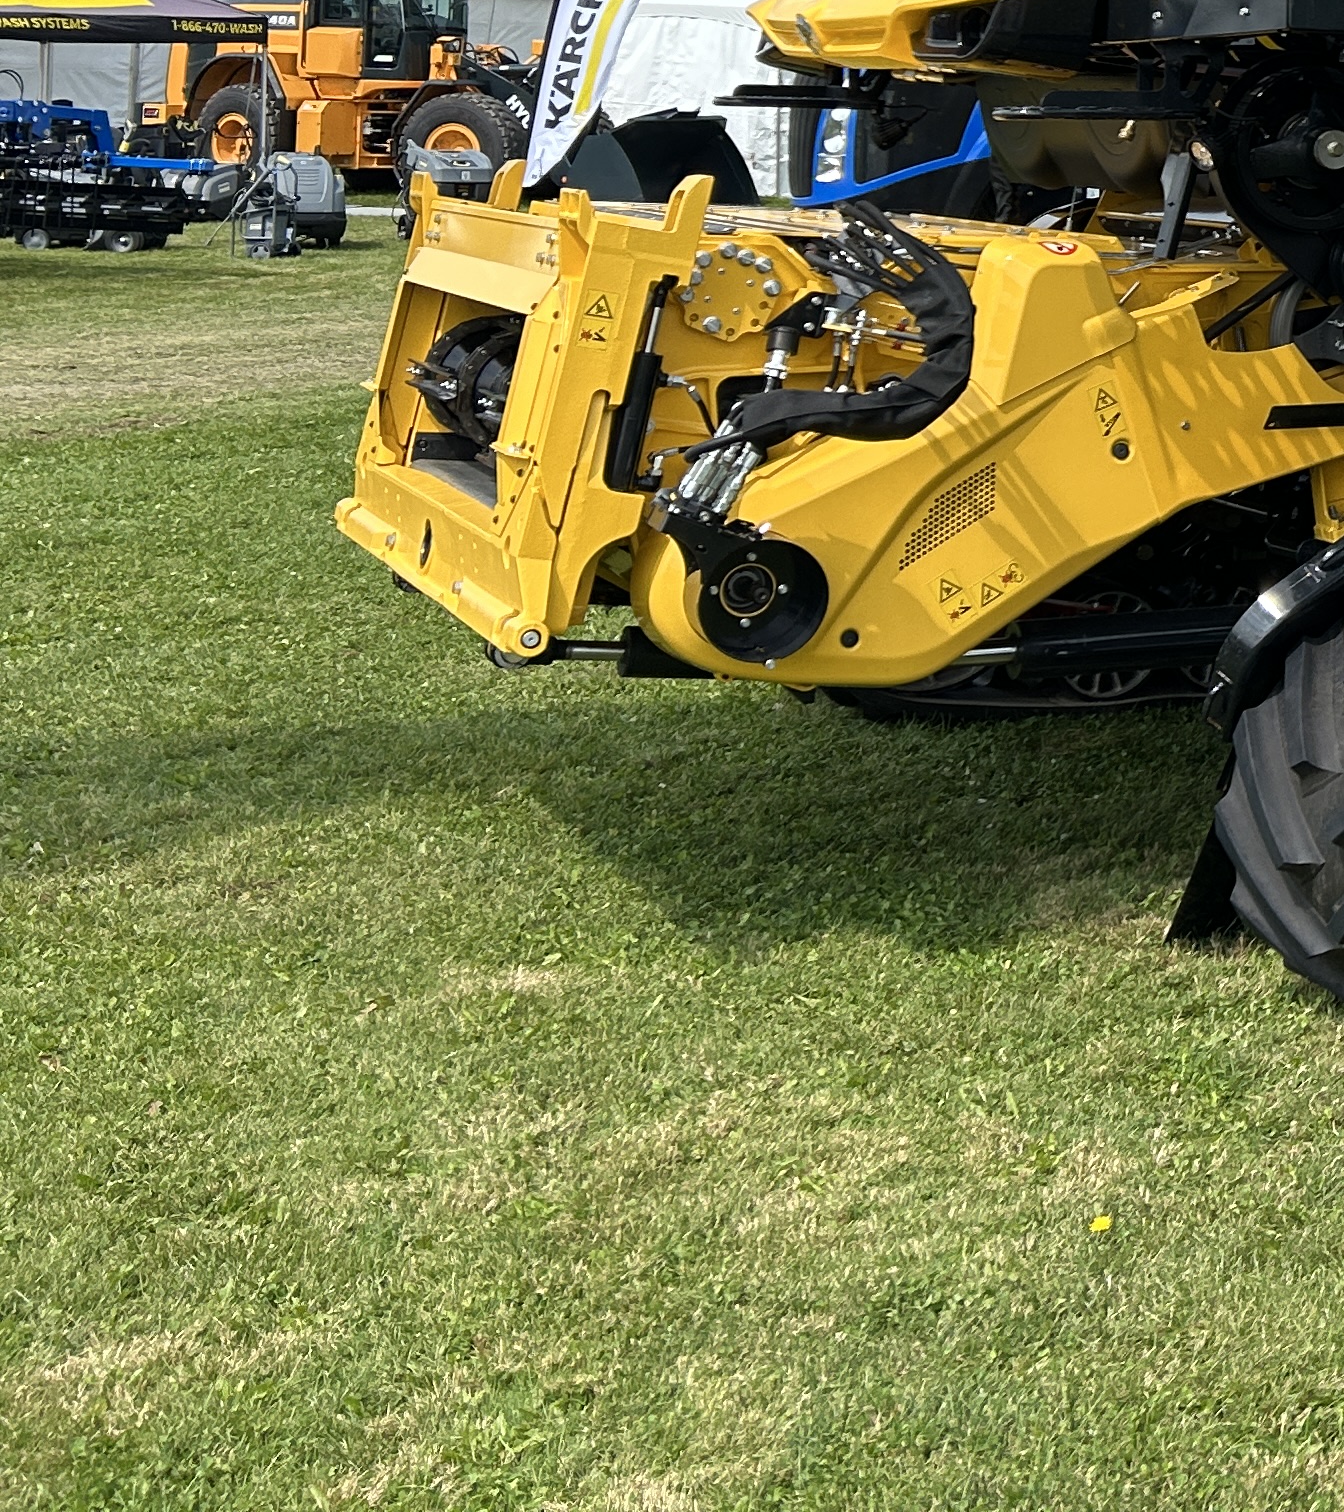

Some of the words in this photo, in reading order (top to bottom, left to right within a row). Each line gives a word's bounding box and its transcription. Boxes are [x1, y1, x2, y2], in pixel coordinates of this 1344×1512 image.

[0, 17, 30, 29] ASH
[30, 17, 91, 30] SYSTEMS
[171, 19, 263, 34] 1-866-470-WASH
[268, 15, 296, 26] 40A
